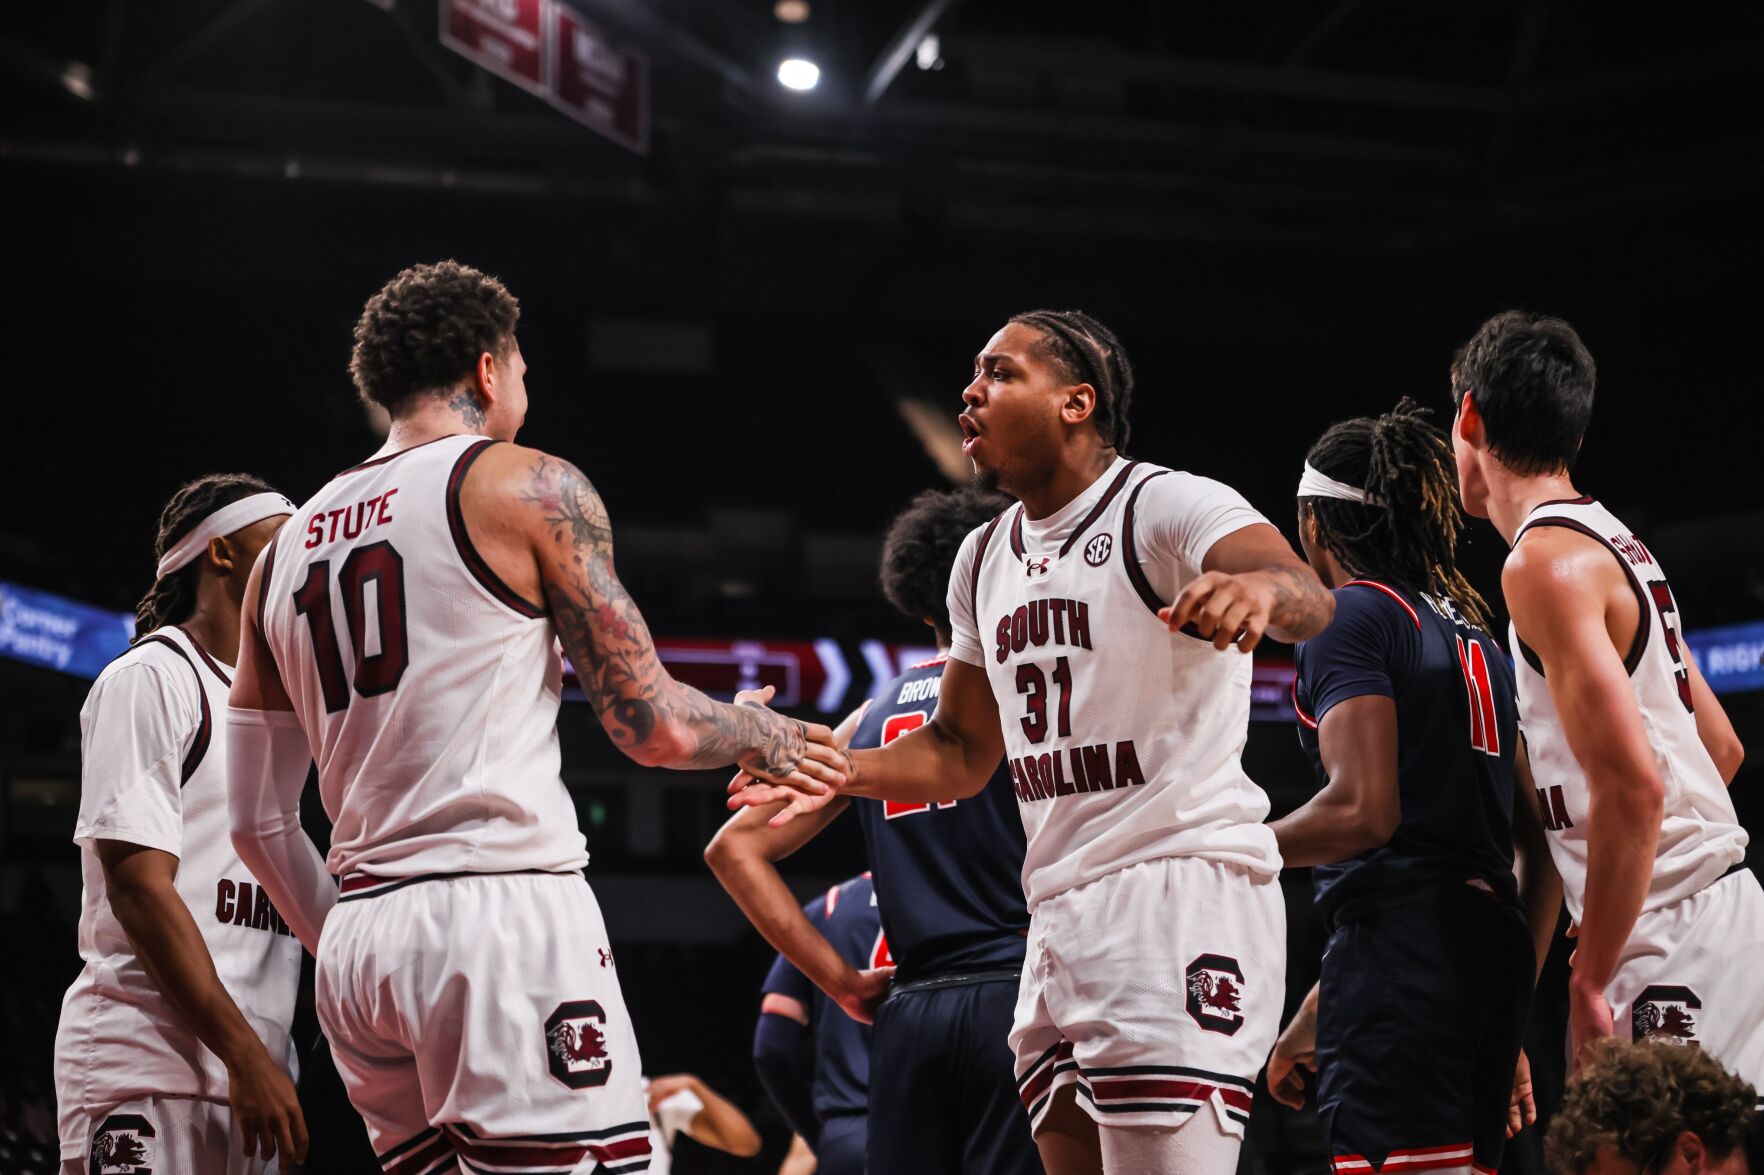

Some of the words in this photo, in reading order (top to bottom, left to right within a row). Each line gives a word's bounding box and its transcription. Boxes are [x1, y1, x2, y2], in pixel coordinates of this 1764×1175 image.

[304, 488, 398, 550] STUTE
[1086, 534, 1111, 564] SEC
[293, 539, 409, 714] 10
[996, 598, 1093, 665] SOUTH
[1015, 656, 1073, 744] 31
[1456, 633, 1500, 757] 11
[1010, 740, 1146, 803] CAROLINA
